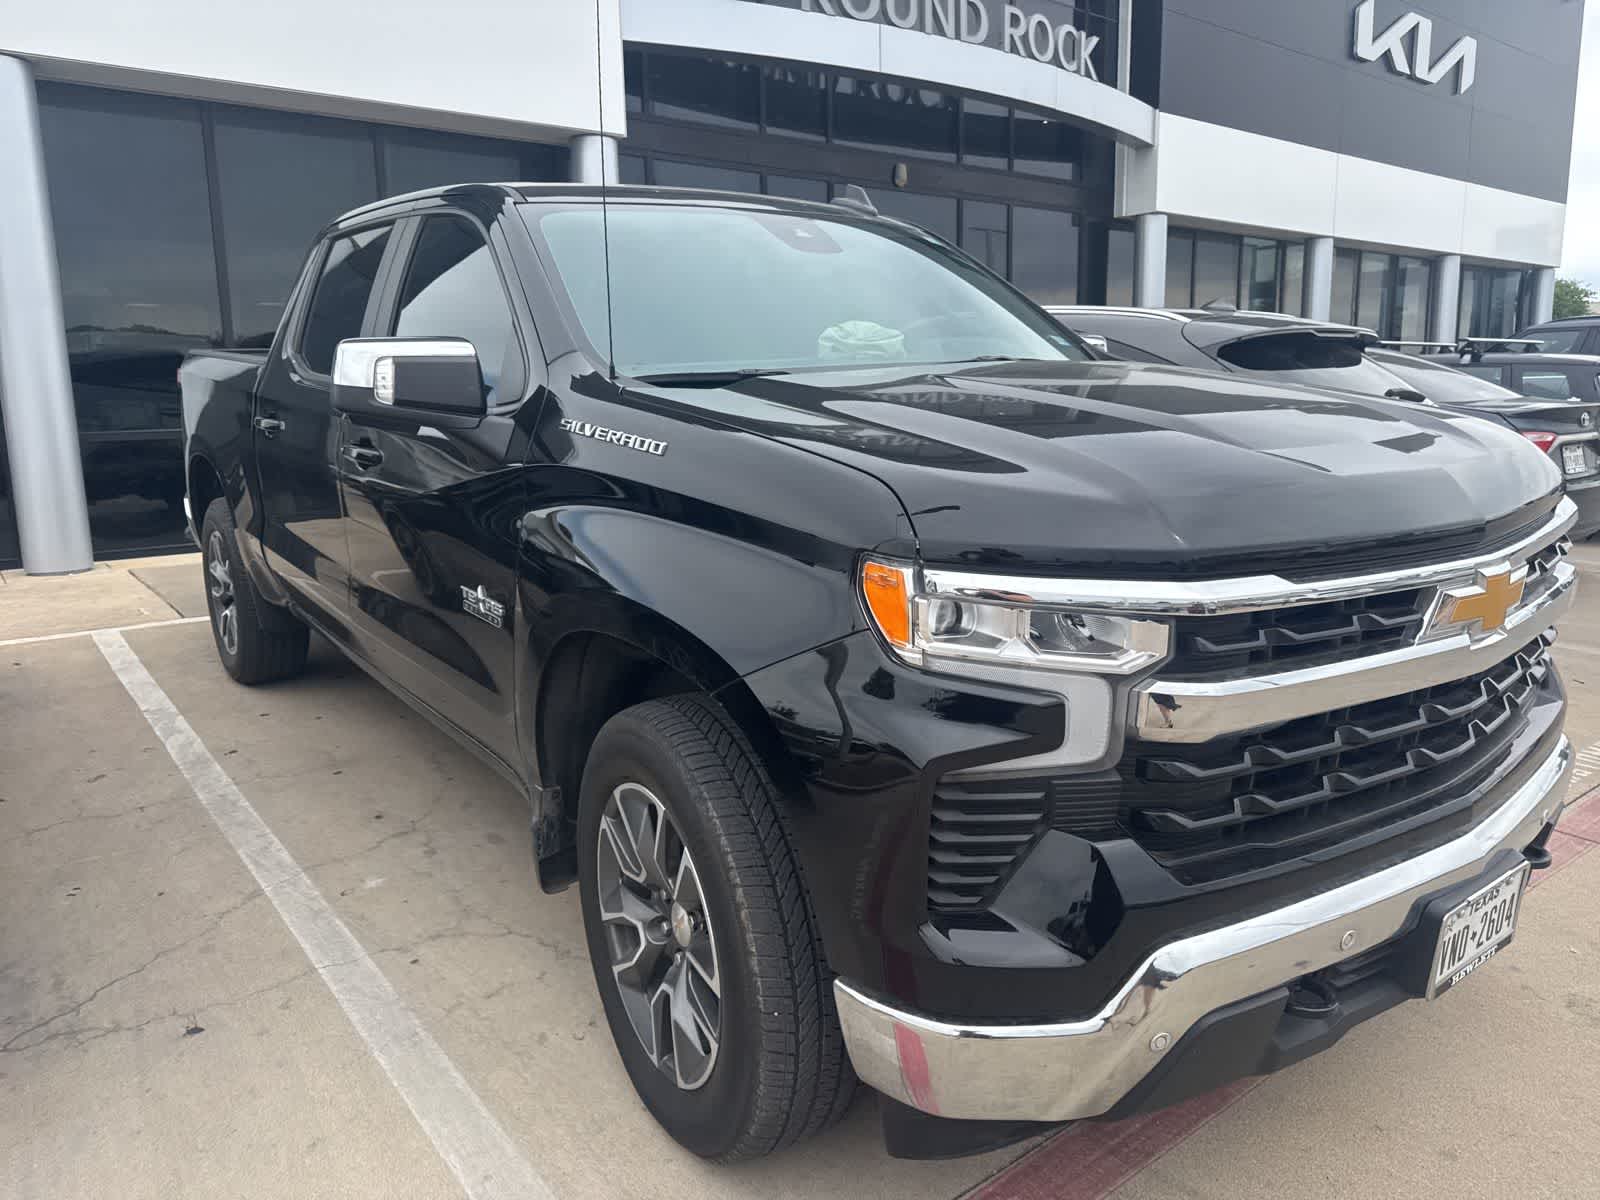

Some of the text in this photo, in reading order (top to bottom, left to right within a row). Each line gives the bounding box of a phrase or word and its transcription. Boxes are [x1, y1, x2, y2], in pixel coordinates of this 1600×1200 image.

[800, 0, 1100, 82] UND ROCK
[1354, 0, 1477, 95] KIA
[560, 418, 668, 456] SILVERADO
[1469, 887, 1501, 916] TEXAS
